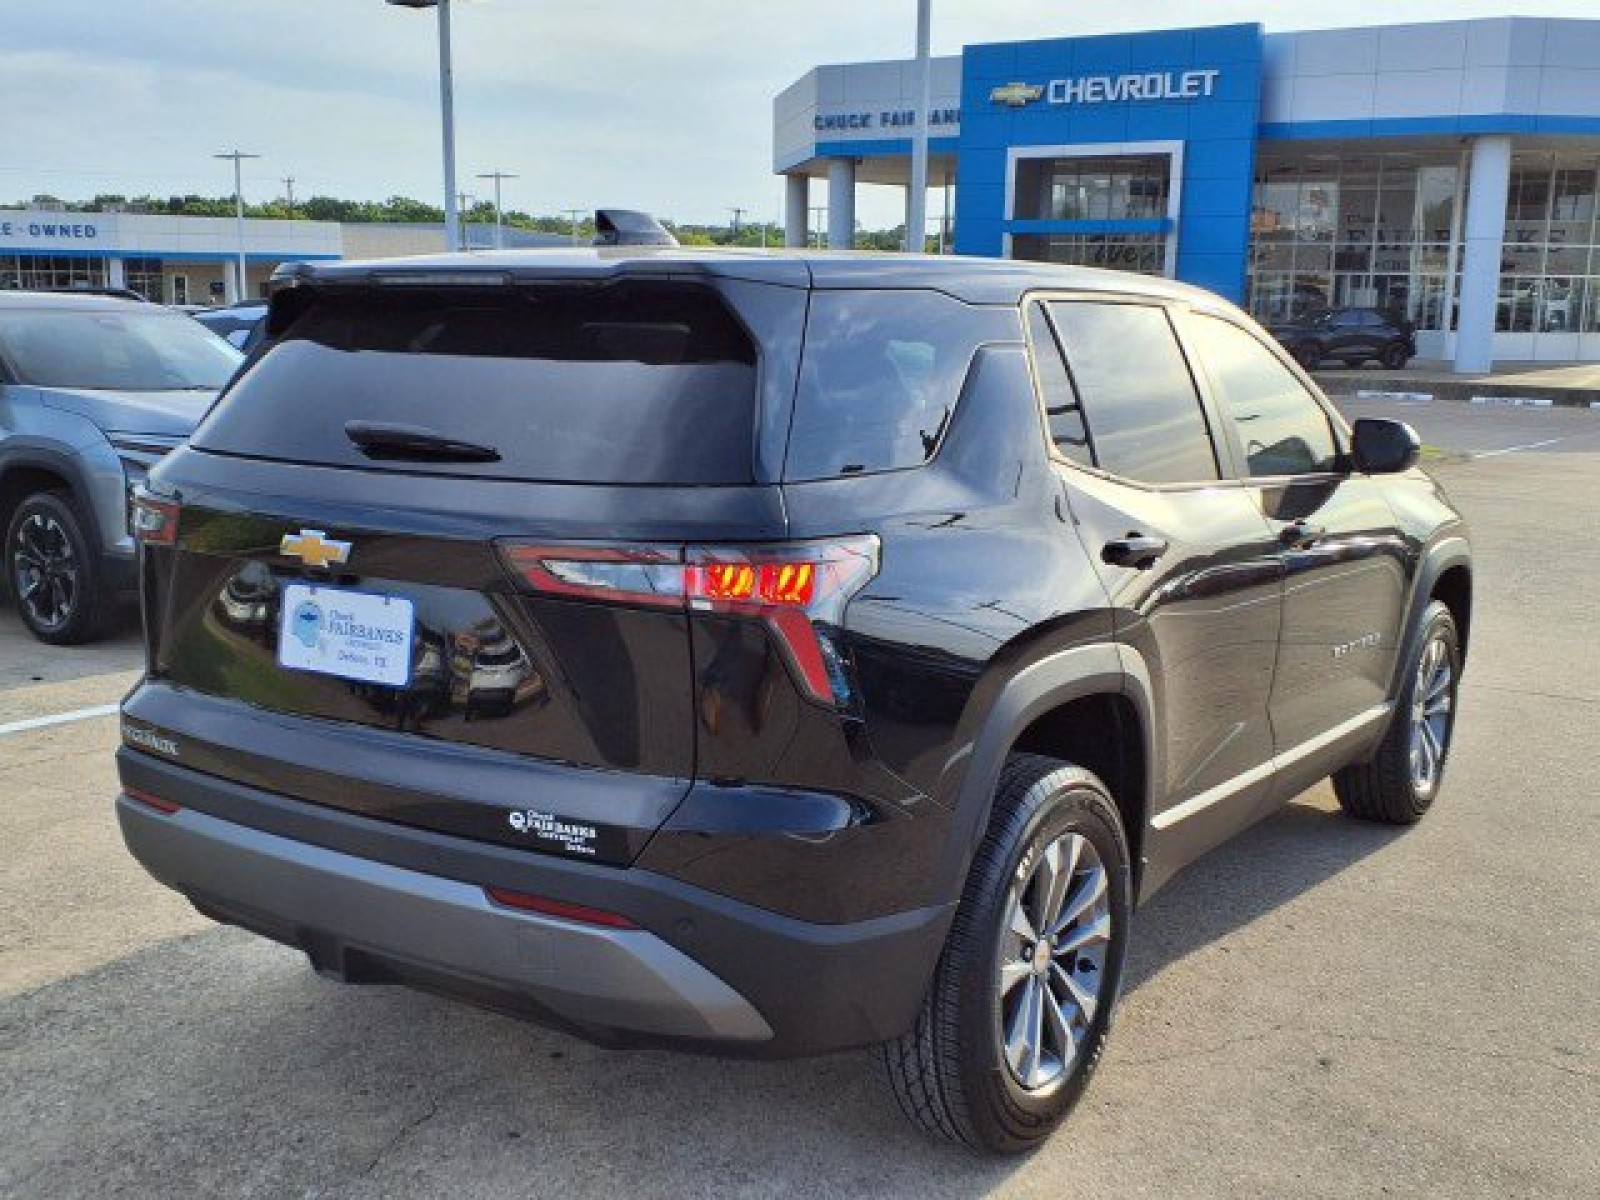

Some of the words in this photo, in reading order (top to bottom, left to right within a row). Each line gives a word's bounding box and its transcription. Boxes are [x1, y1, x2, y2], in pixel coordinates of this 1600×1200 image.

[1047, 69, 1220, 105] CHEVROLET
[814, 112, 873, 131] CHUCK
[879, 108, 961, 129] FAIRAN
